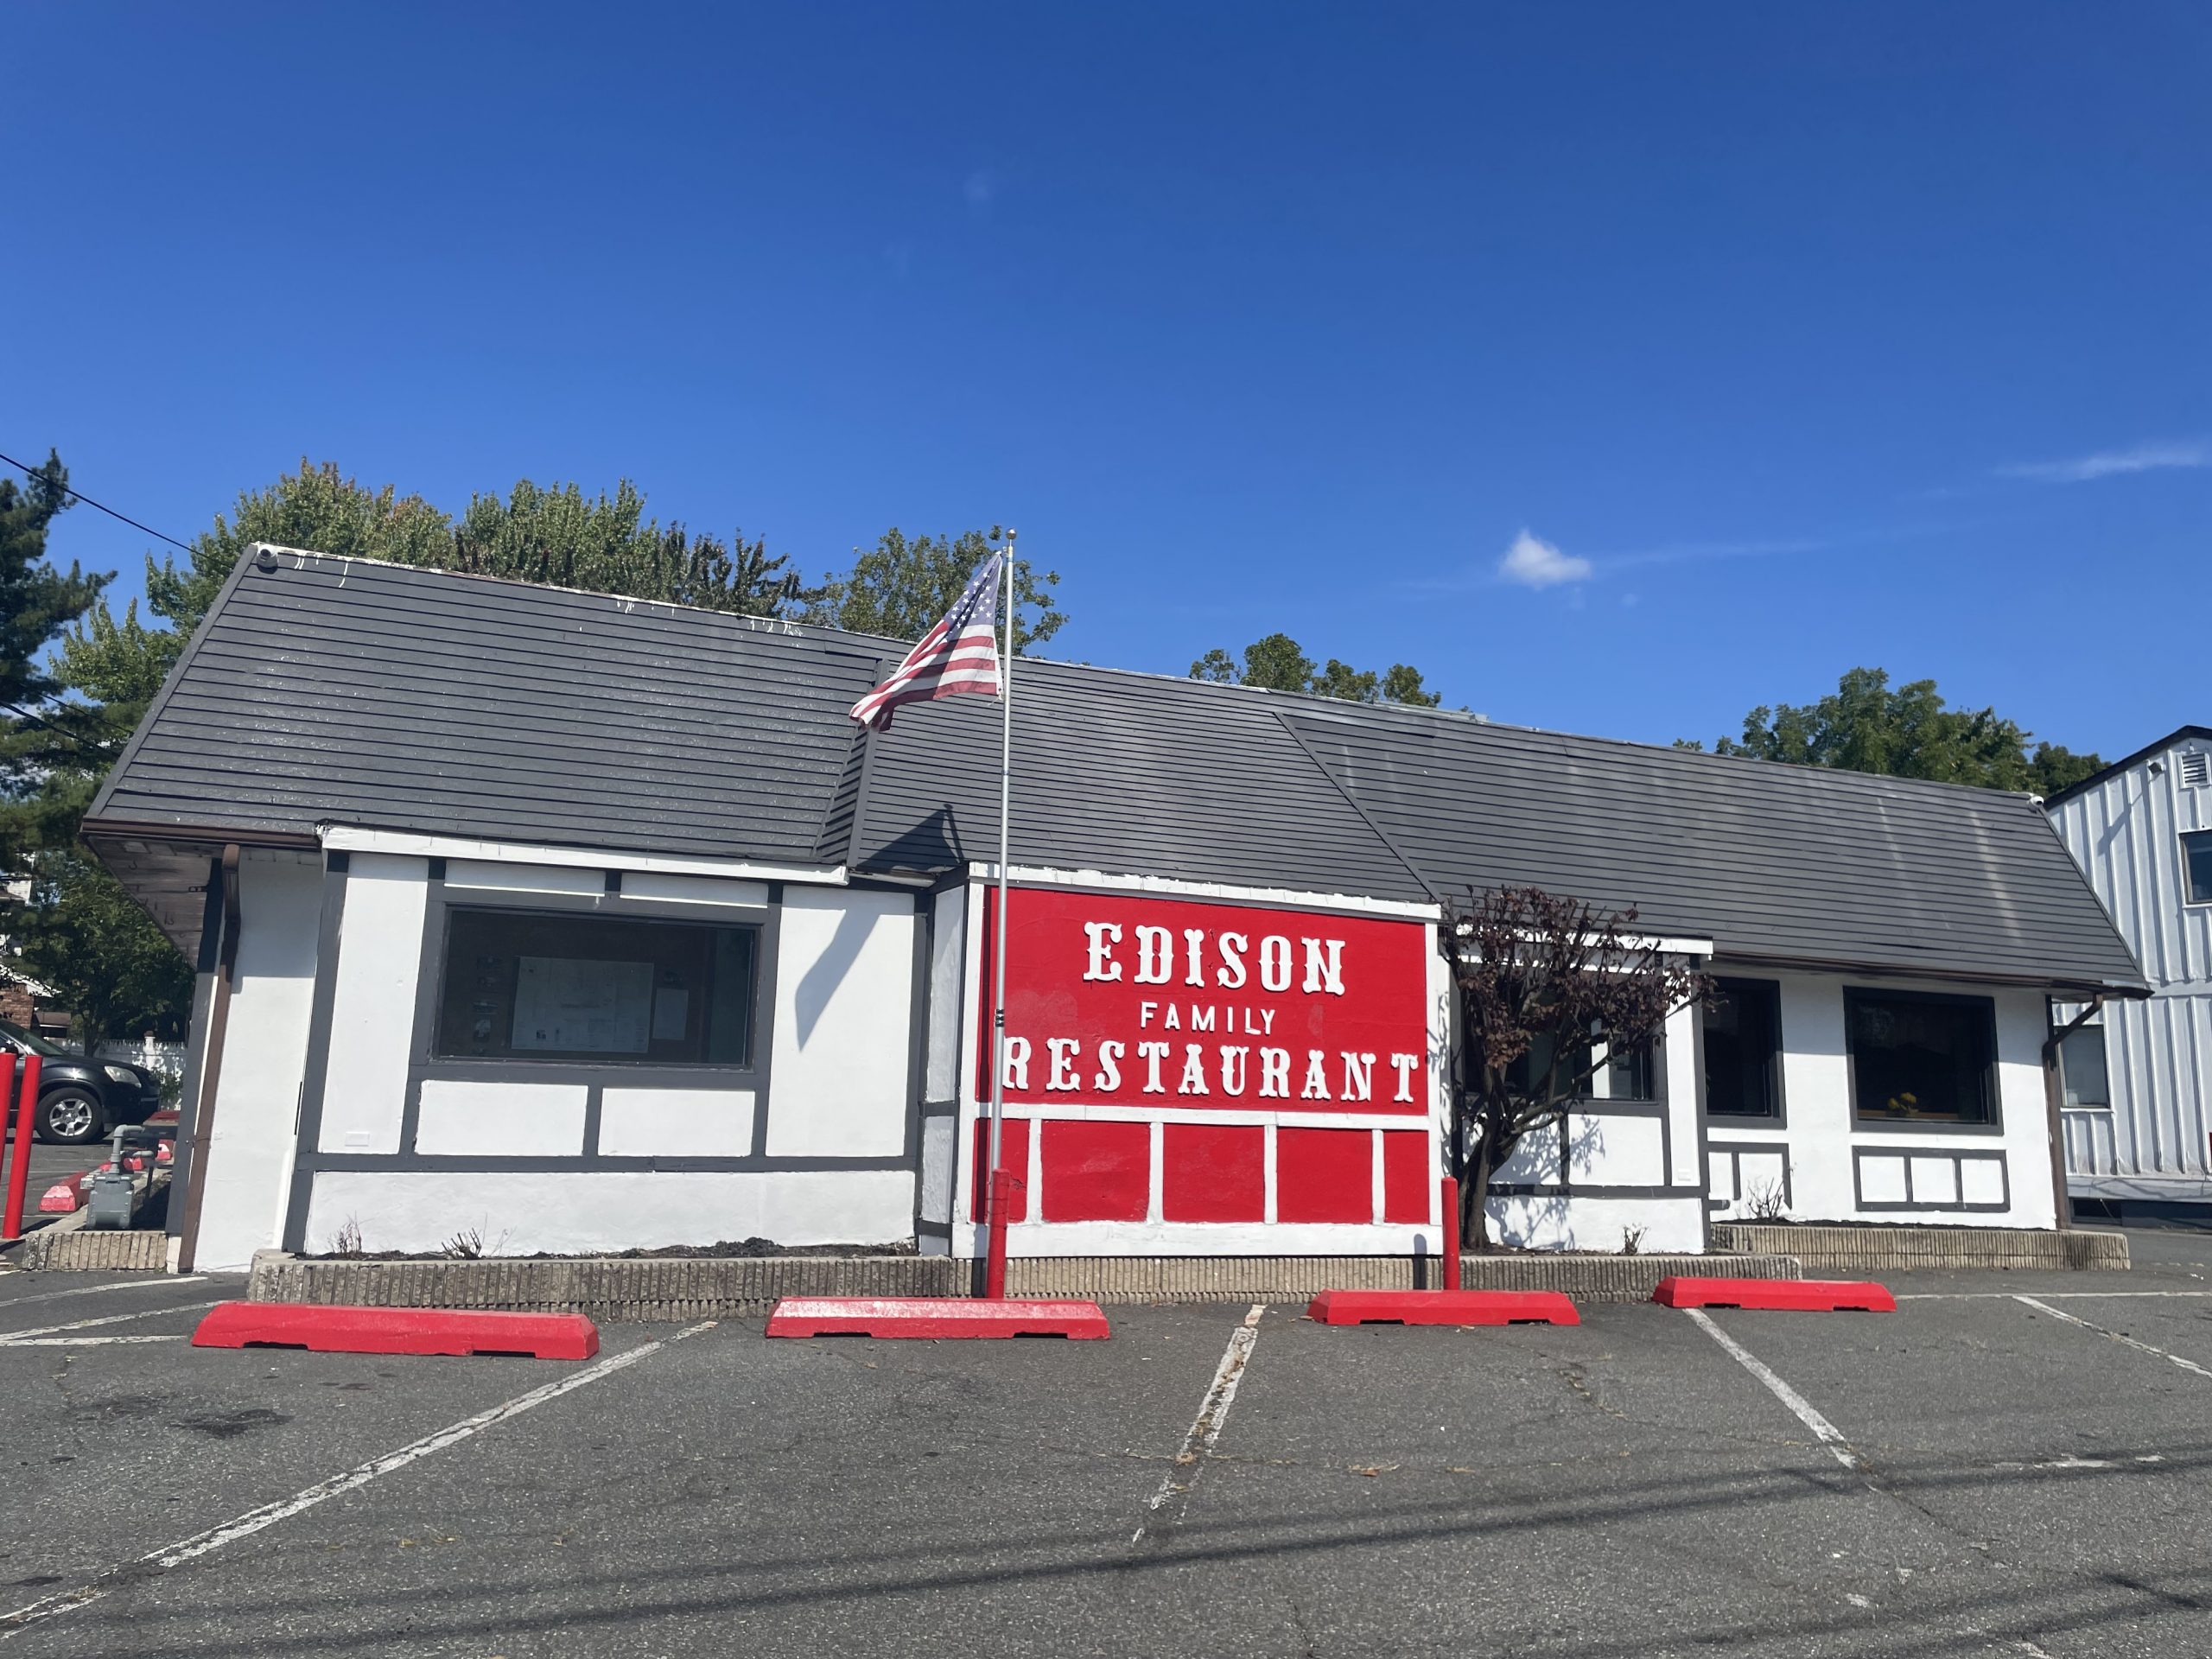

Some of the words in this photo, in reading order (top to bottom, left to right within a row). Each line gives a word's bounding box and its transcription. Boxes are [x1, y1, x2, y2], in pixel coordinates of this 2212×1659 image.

[1083, 921, 1345, 995] EDISON
[1140, 1001, 1275, 1034] FAMILY
[1001, 1036, 1418, 1103] RESTAURANT
